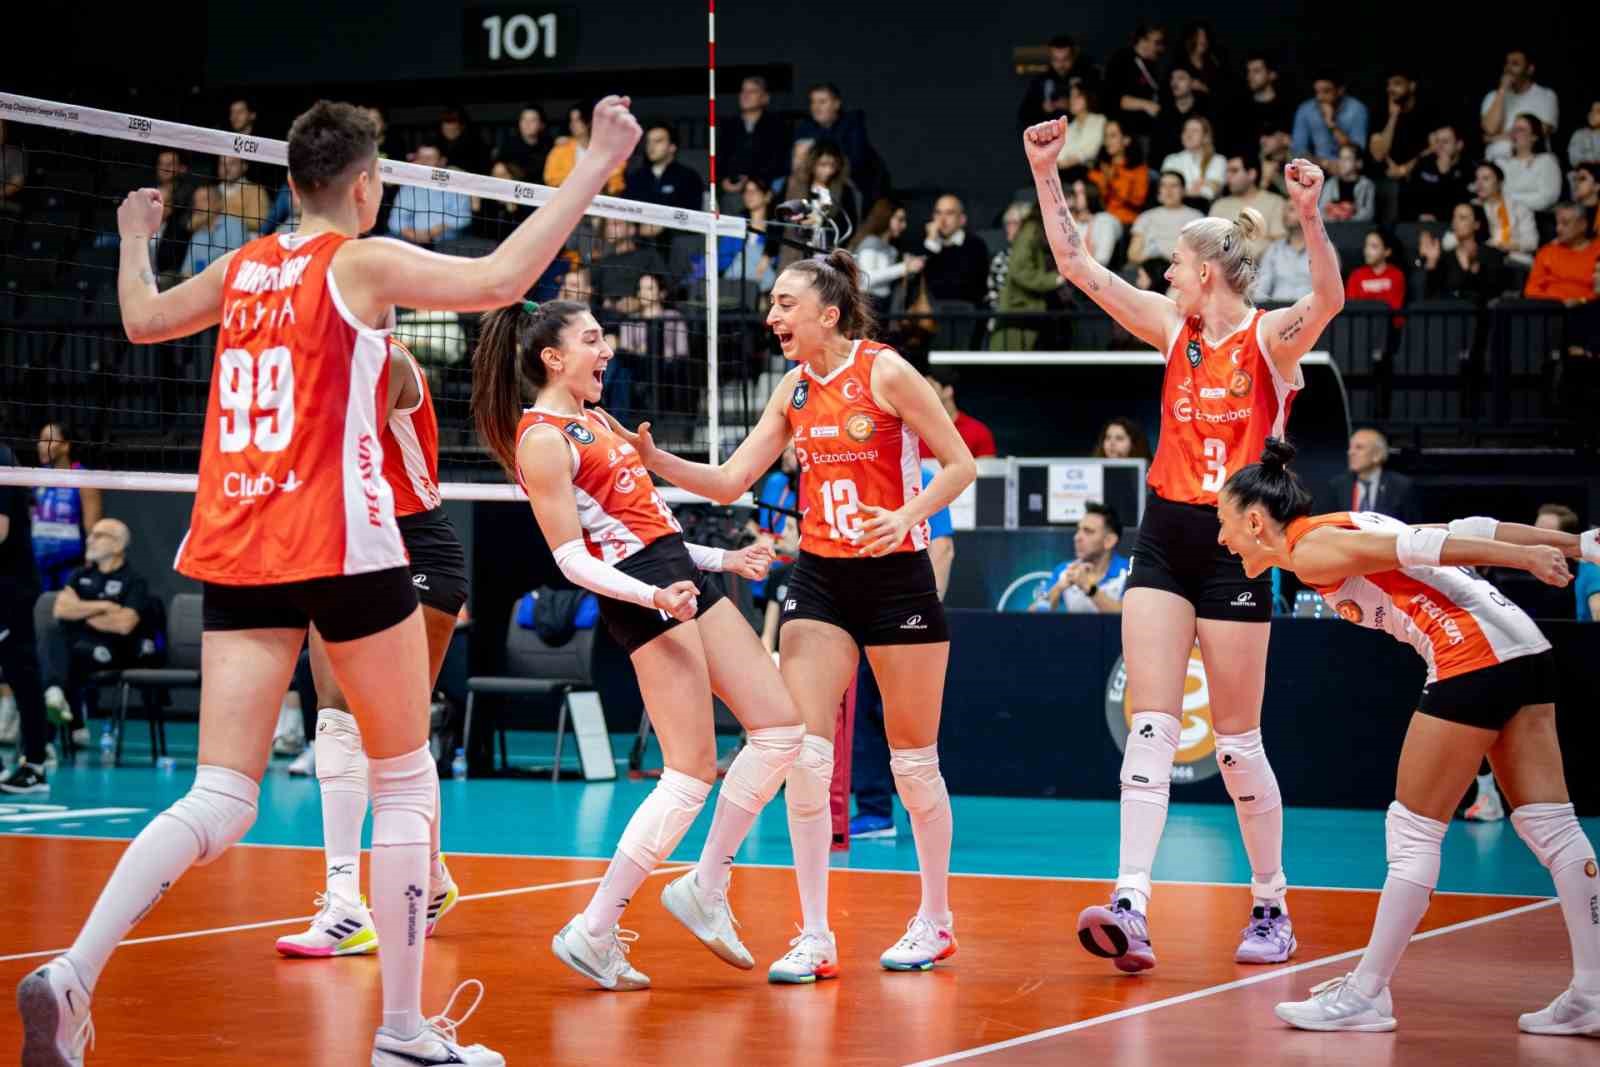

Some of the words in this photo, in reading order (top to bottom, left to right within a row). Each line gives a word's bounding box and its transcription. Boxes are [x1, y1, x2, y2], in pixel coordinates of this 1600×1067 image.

[482, 13, 557, 60] 101
[128, 117, 151, 131] ZEREN
[244, 140, 259, 153] CEV
[219, 345, 295, 453] 99
[223, 472, 275, 497] Club
[1202, 438, 1227, 492] 3
[820, 479, 864, 541] 12
